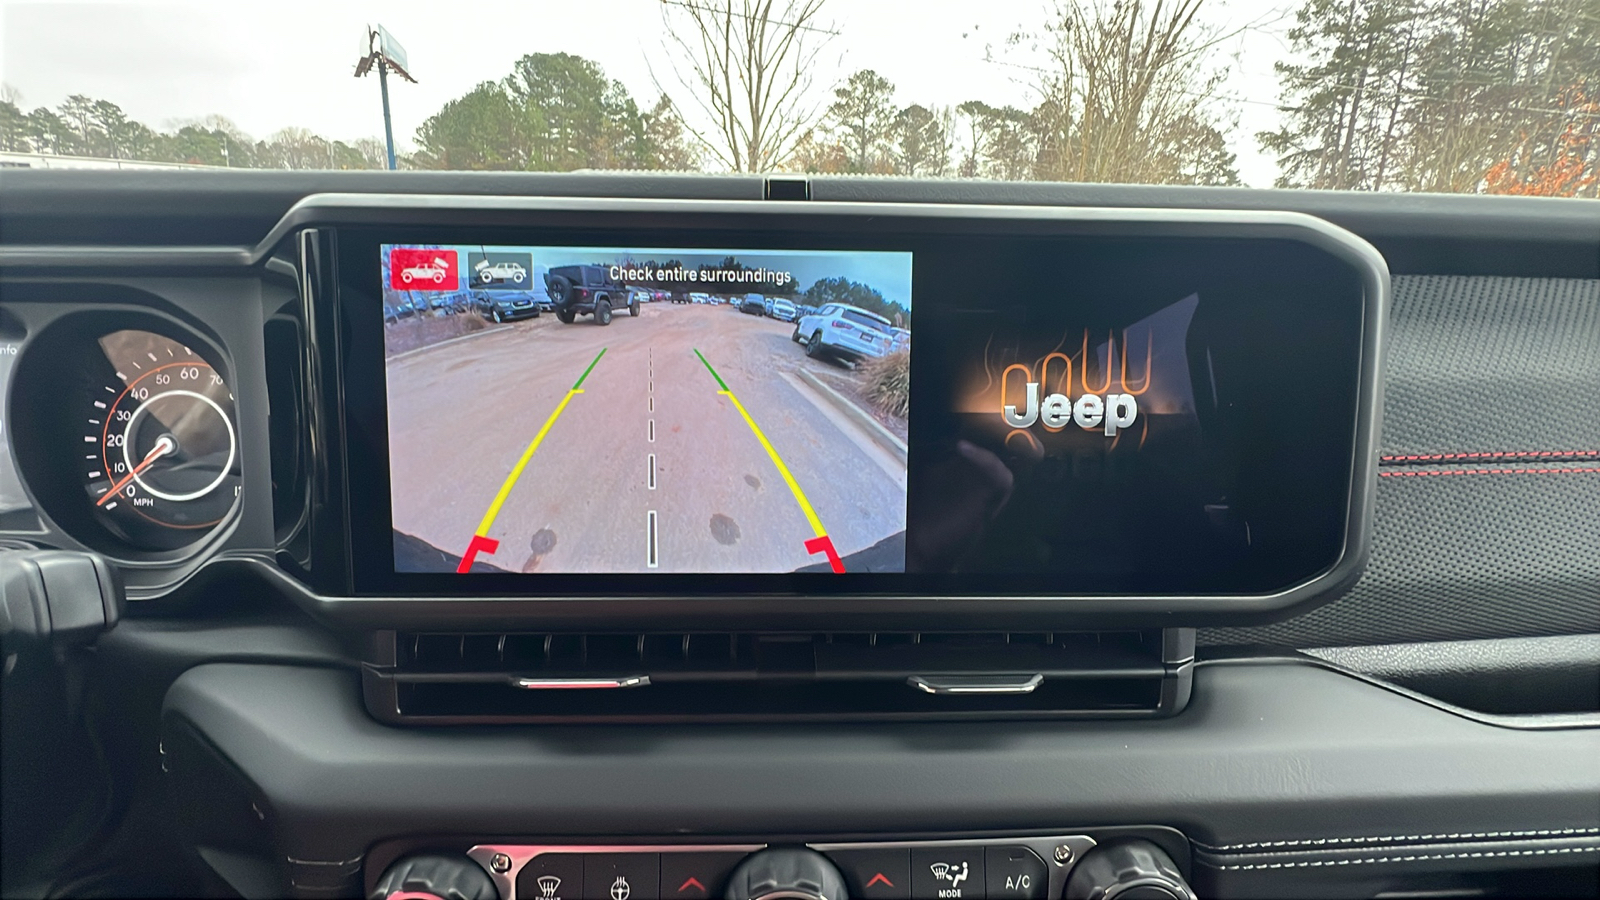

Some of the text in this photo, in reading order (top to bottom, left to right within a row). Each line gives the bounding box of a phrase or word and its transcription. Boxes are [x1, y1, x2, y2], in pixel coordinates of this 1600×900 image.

[609, 266, 792, 286] Check entire surroundings
[155, 374, 171, 385] 50
[180, 367, 200, 380] 60
[209, 374, 224, 386] 70
[130, 387, 149, 400] 40
[116, 410, 132, 421] 30
[1004, 382, 1138, 437] Jeep
[106, 434, 125, 447] 20
[114, 462, 126, 473] 10
[125, 484, 136, 498] 0
[133, 498, 154, 507] MPH
[1005, 874, 1031, 891] A/C
[938, 889, 962, 898] MODE
